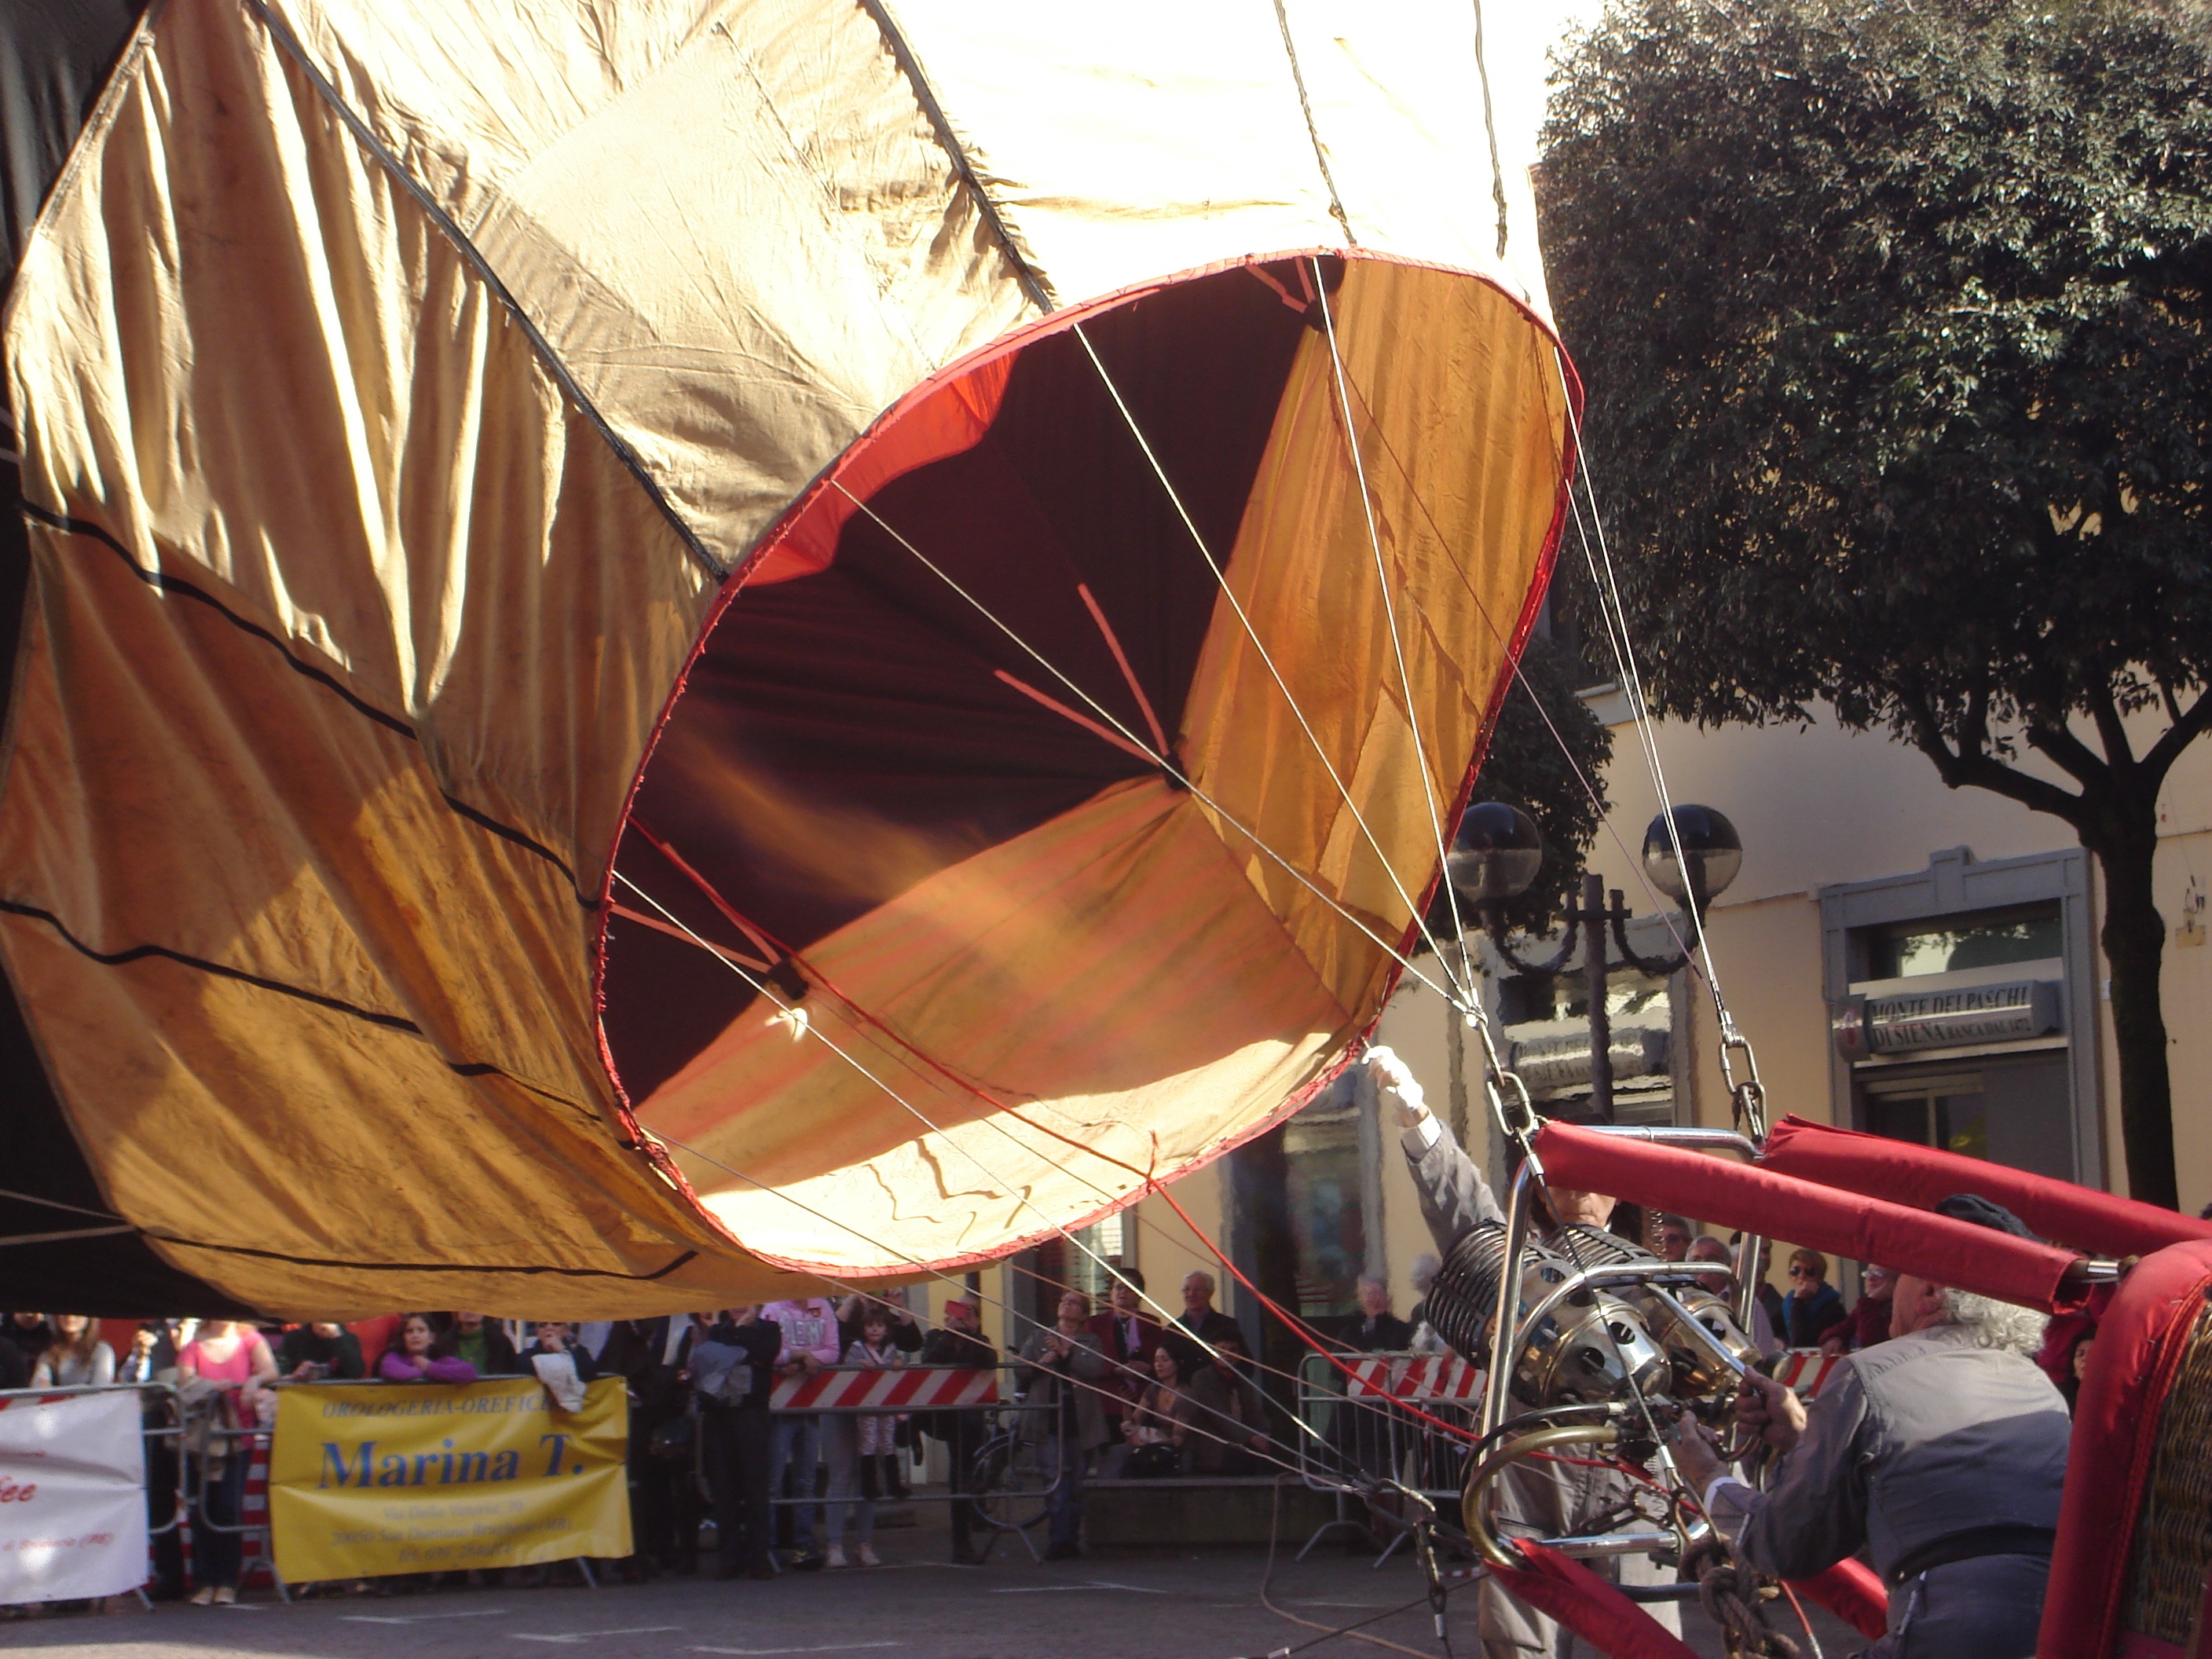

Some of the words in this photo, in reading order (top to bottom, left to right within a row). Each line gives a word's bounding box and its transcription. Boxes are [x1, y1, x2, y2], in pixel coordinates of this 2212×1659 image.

[1872, 998, 1927, 1020] MONTE
[1932, 994, 1961, 1014] DEI
[1966, 986, 2028, 1010] PASCHI
[1873, 1026, 1892, 1047] DI
[1894, 1022, 1946, 1045] SIENA
[316, 1438, 520, 1490] Marina
[539, 1433, 584, 1478] T.
